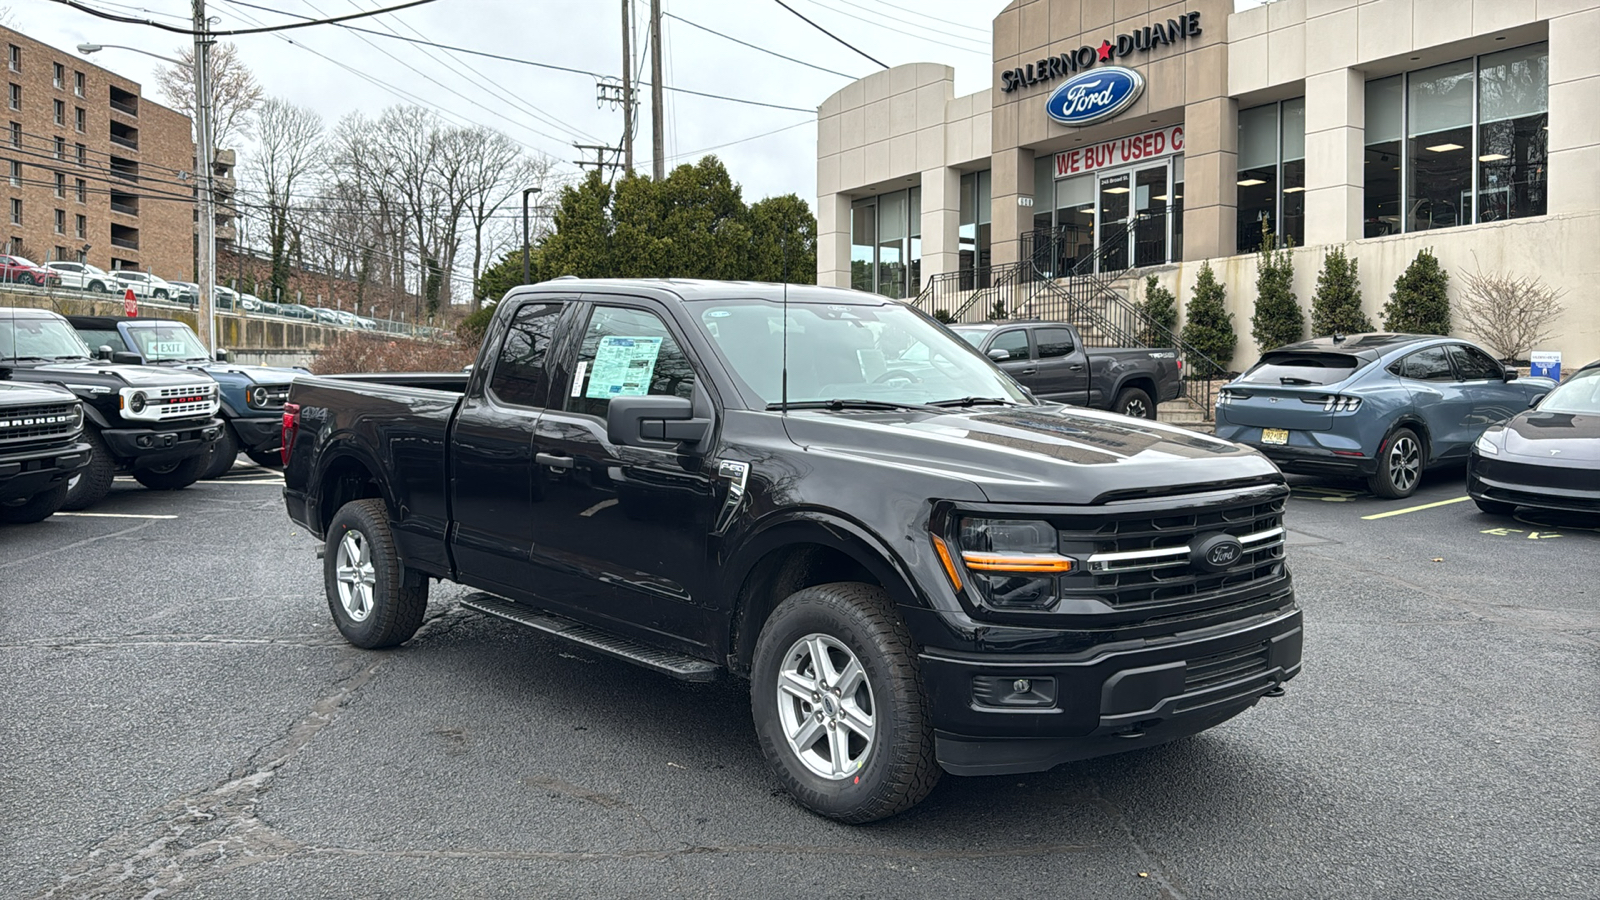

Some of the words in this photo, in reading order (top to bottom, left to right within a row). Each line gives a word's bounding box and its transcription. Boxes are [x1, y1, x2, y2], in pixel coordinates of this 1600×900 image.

[1001, 46, 1096, 93] SALERNO
[1116, 11, 1202, 58] DUANE
[1062, 80, 1114, 116] Ford
[1057, 151, 1080, 175] WE
[1084, 142, 1117, 170] BUY
[1121, 132, 1166, 162] USED
[125, 299, 137, 314] STOP
[160, 343, 181, 353] EXIT
[170, 396, 202, 404] FORD
[0, 415, 66, 428] BRONCO
[1213, 545, 1234, 562] Ford
